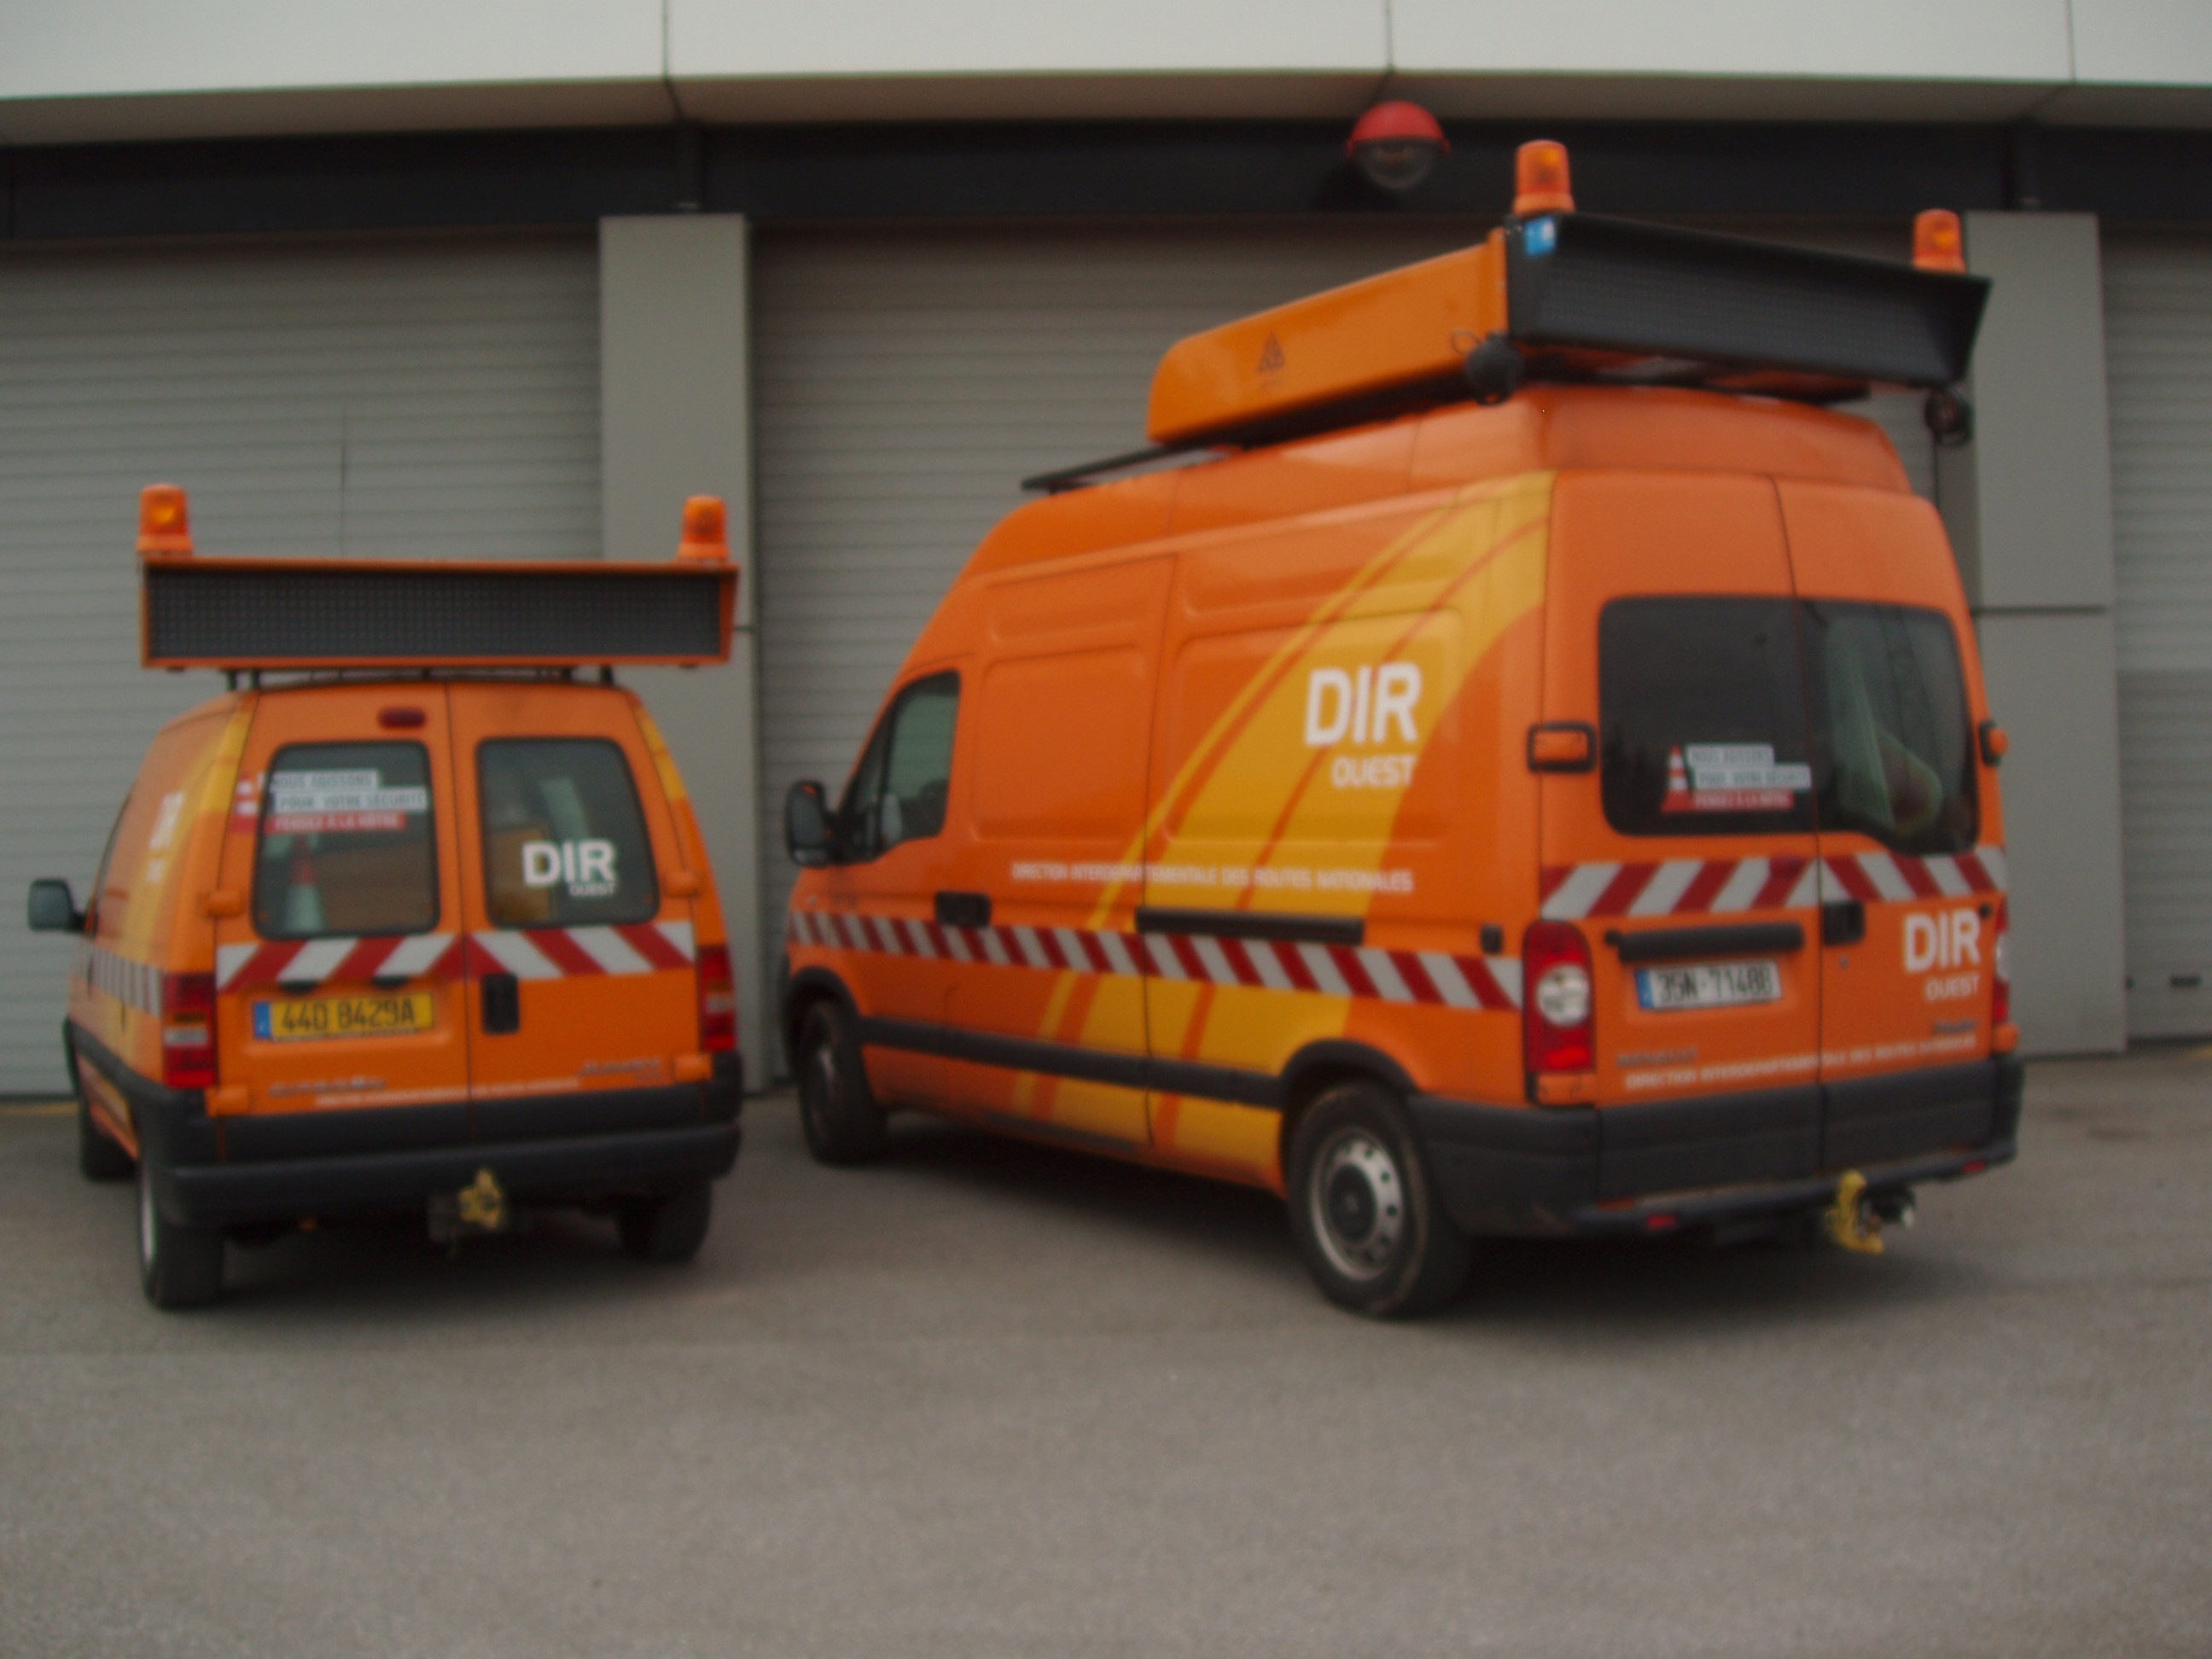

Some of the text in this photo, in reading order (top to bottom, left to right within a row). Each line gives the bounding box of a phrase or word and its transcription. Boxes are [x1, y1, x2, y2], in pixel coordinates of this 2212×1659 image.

[1305, 661, 1422, 746] DIR
[1331, 754, 1417, 789] OUEST
[522, 841, 614, 885] DIR
[1222, 867, 1250, 886] DES
[1254, 867, 1312, 888] ROUTES
[1317, 869, 1413, 892] NATIONALES
[568, 883, 615, 897] OUEST
[1905, 911, 1981, 972] DIR
[1926, 973, 1980, 1001] OUEST
